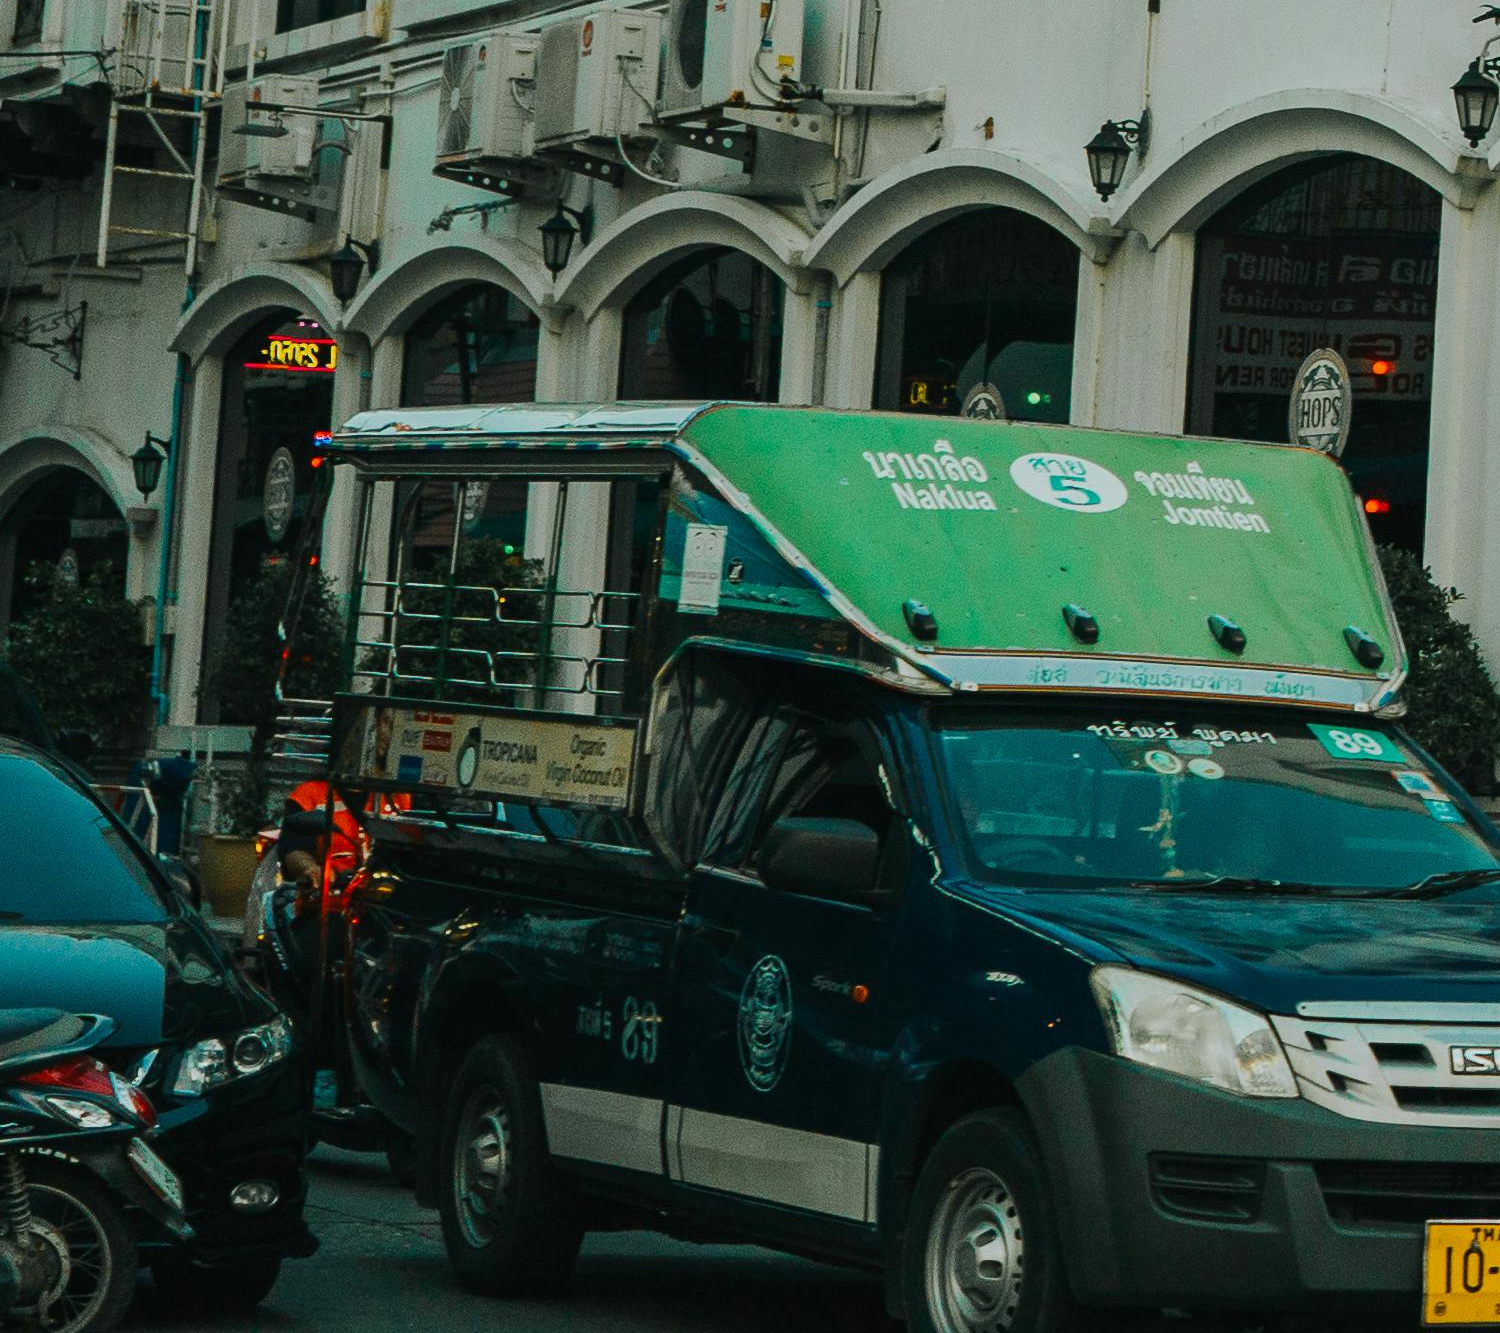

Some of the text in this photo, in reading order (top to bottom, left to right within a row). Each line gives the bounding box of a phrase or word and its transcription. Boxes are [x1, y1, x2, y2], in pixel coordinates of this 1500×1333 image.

[1300, 395, 1341, 429] HOPS
[863, 440, 989, 484] นาเกลือ
[1028, 456, 1086, 476] สาย
[892, 483, 997, 511] Naklua
[1048, 475, 1101, 506] 5
[1134, 461, 1254, 506] จอมเทียน
[1163, 500, 1271, 533] Jomtien
[483, 740, 538, 764] TROPICANA
[1328, 729, 1384, 756] 89
